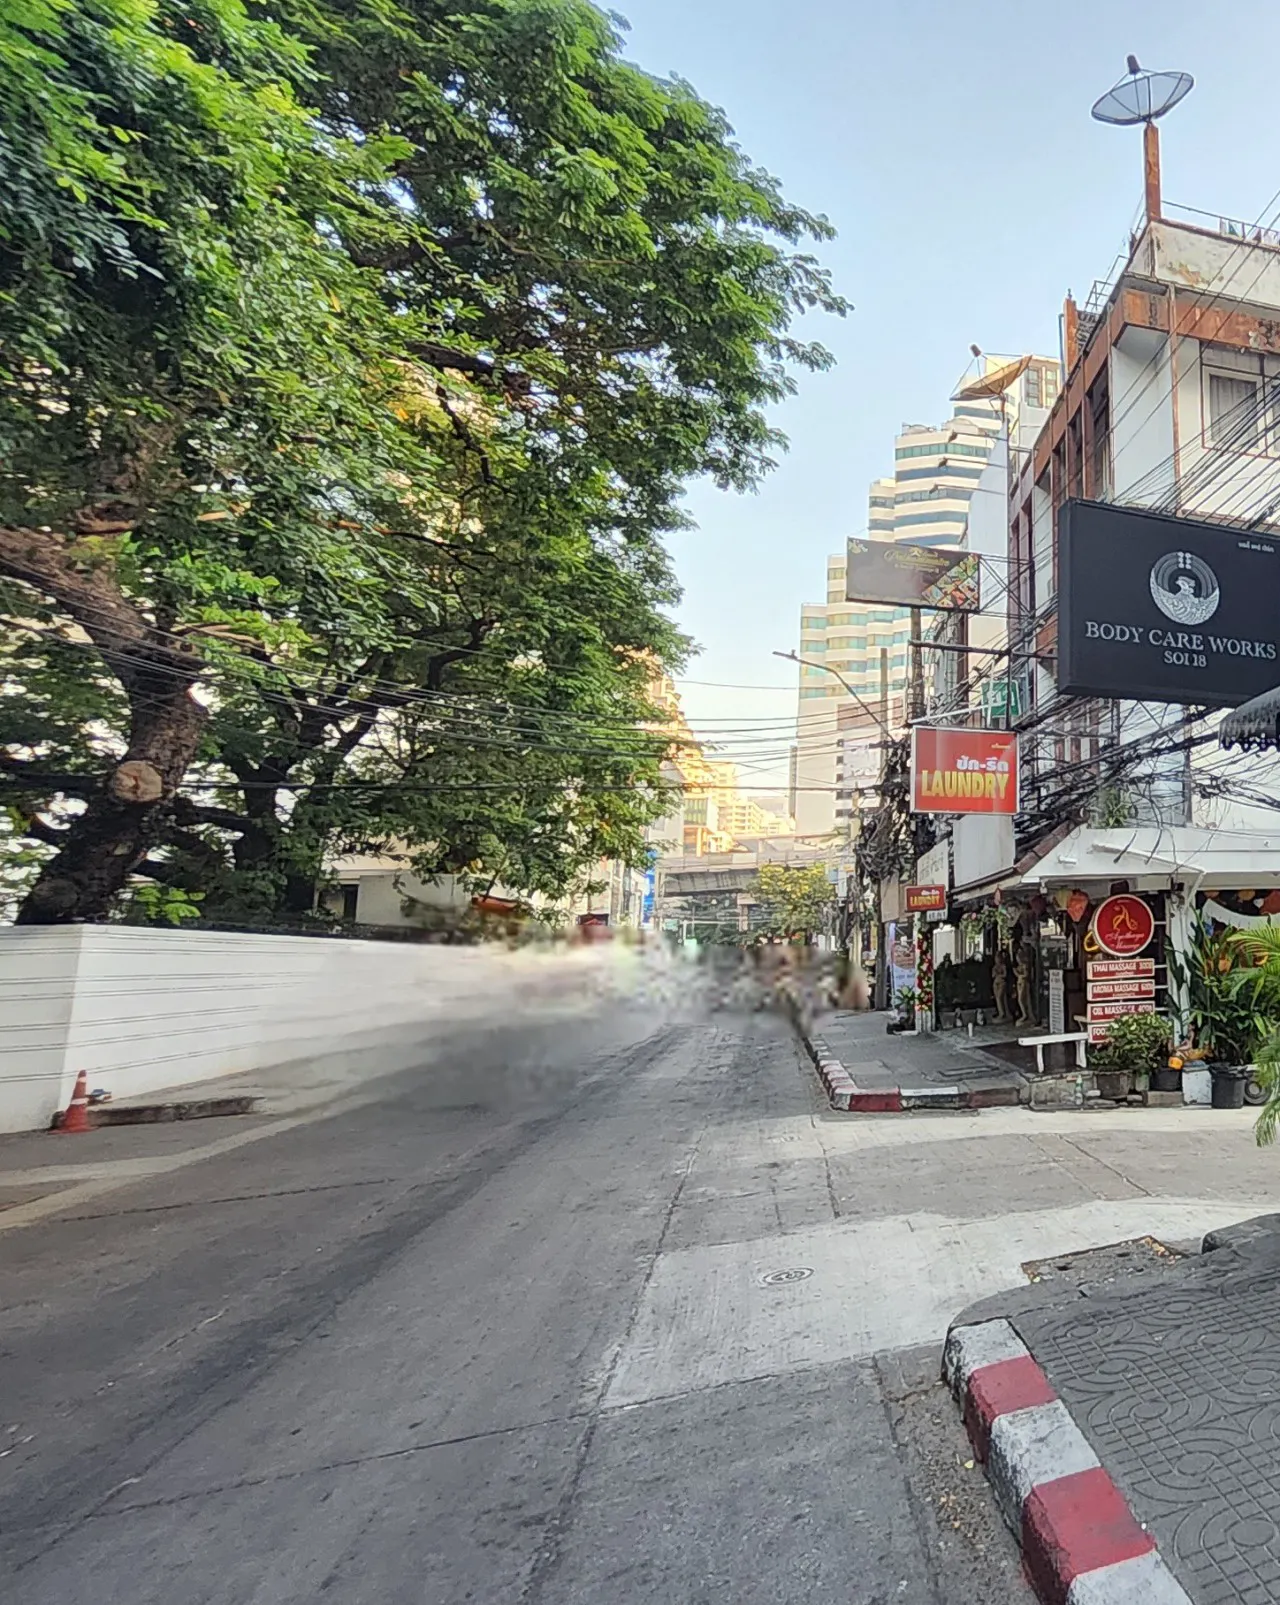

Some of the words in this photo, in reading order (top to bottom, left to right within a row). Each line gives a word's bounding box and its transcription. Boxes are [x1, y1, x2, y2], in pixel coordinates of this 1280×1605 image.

[1086, 621, 1144, 643] BODY
[1148, 629, 1204, 651] CARE
[1208, 636, 1277, 660] WORKS
[1164, 650, 1190, 666] SOI
[1192, 654, 1207, 668] 18
[921, 769, 1010, 800] LAUNDRY
[1093, 963, 1108, 973] THAI
[1109, 962, 1137, 972] MASSAGE
[1114, 983, 1139, 993] MASSAGE
[1093, 1028, 1108, 1036] FOO
